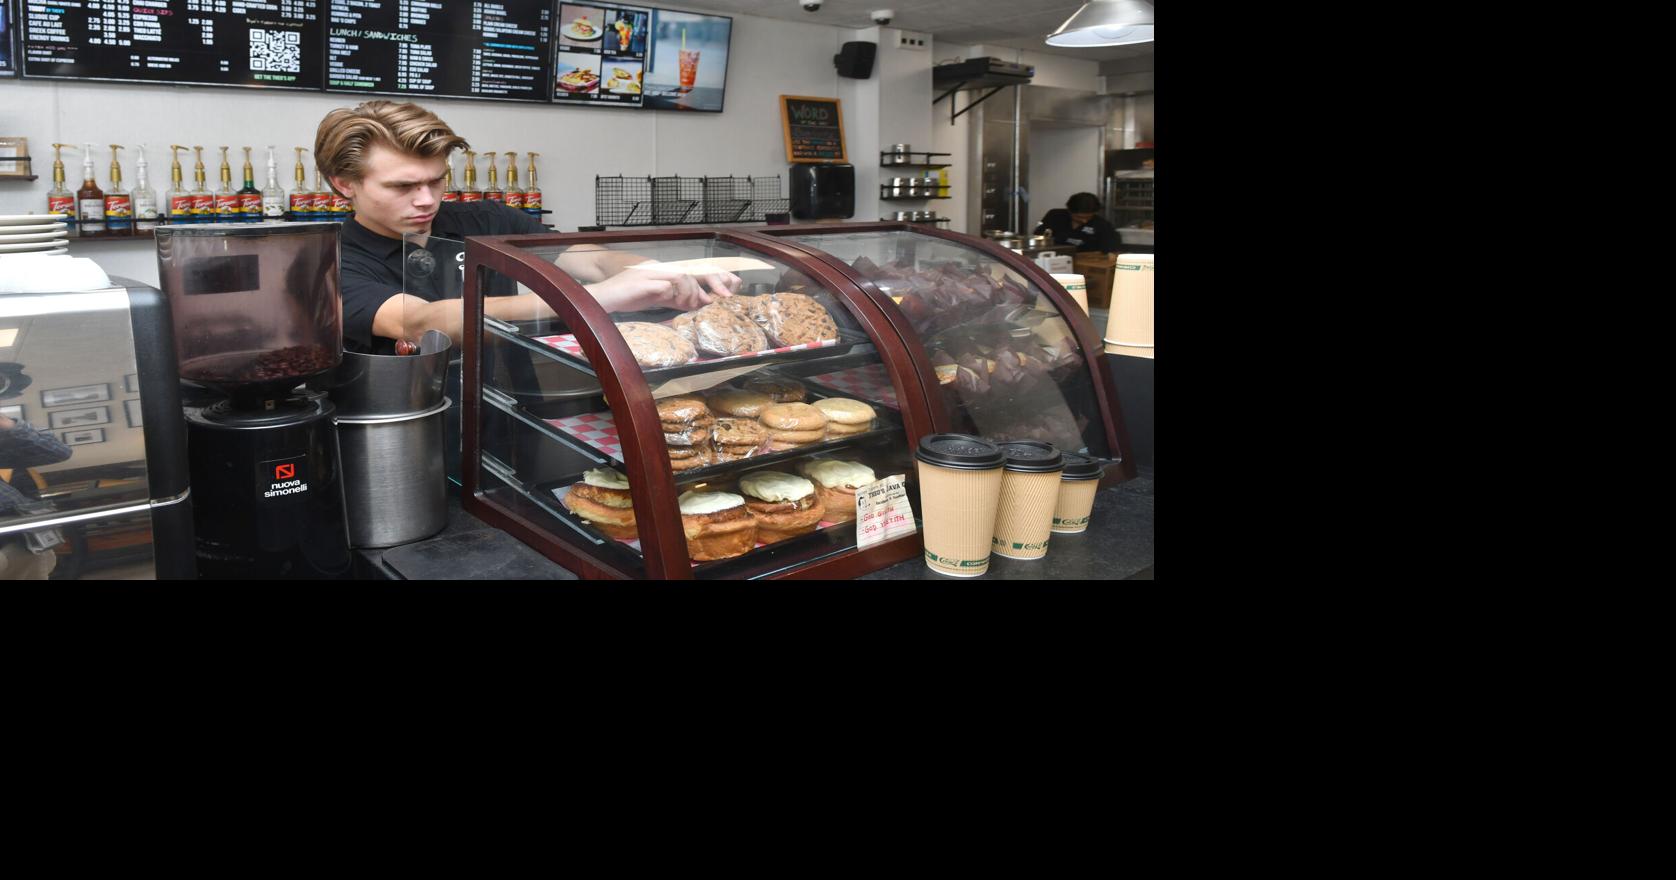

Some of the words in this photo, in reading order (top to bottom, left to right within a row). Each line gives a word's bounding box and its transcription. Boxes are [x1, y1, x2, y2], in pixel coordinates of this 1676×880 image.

[363, 31, 417, 42] SANDWICHES
[272, 480, 300, 490] nuova
[886, 482, 901, 492] JAVA
[264, 484, 308, 498] simonelli
